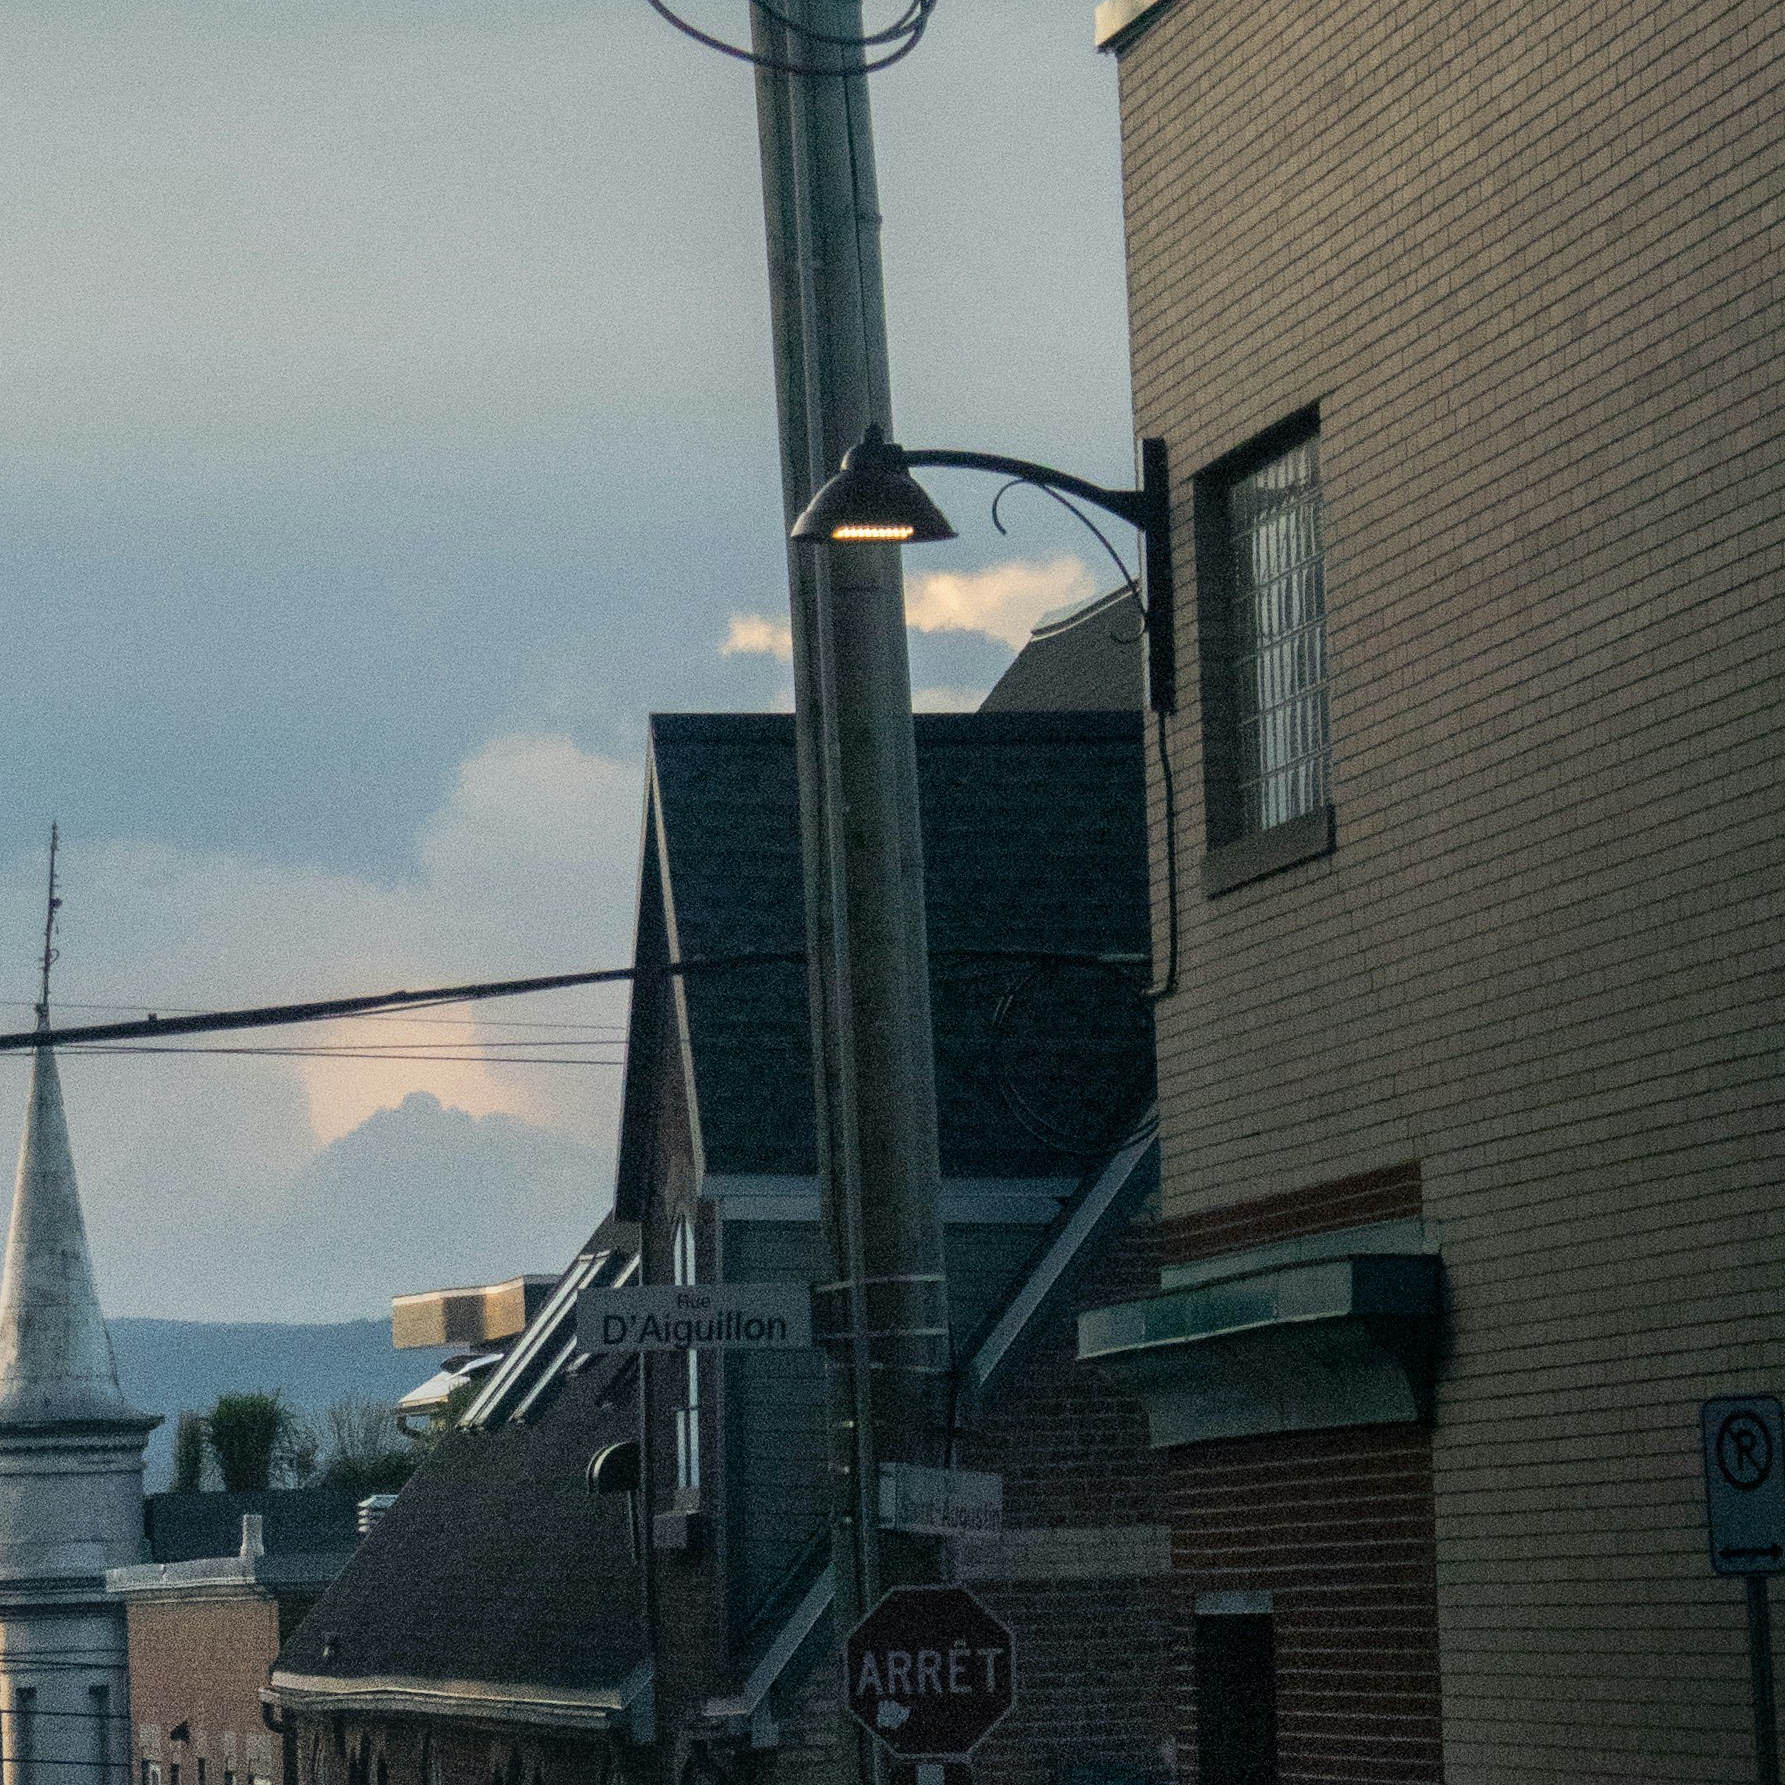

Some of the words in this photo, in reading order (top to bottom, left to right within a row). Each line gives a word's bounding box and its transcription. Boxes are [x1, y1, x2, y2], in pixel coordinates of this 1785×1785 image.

[677, 1293, 710, 1310] Rue
[602, 1311, 787, 1350] D'Aiguillon
[855, 1639, 1004, 1696] ARRÊT
